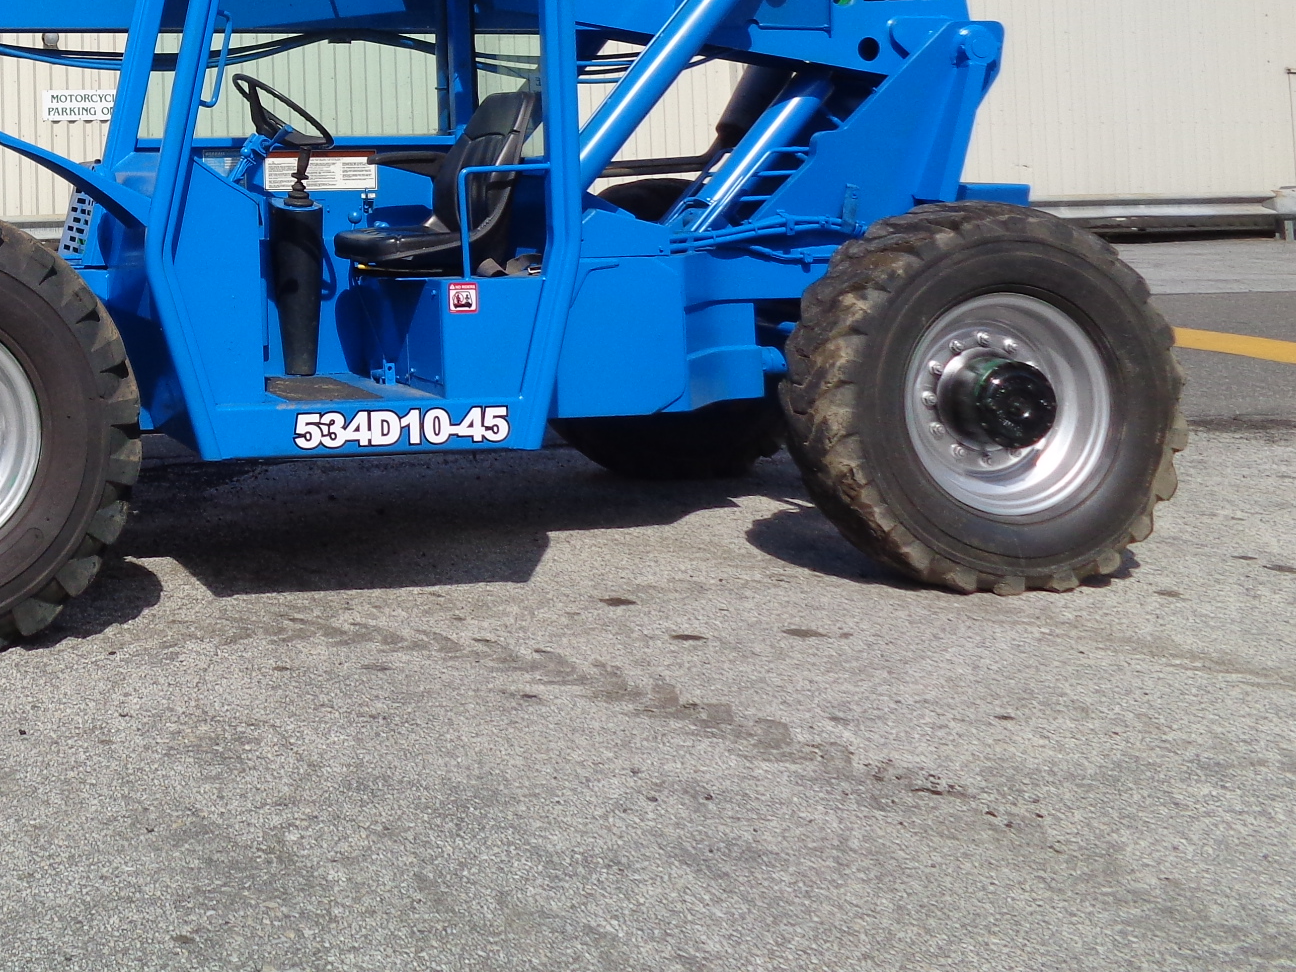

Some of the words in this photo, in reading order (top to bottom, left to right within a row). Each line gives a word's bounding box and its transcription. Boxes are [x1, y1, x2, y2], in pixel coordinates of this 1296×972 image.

[50, 94, 116, 104] MOTORCYCL
[47, 106, 97, 116] PARKING
[294, 406, 510, 450] 534D10-45
